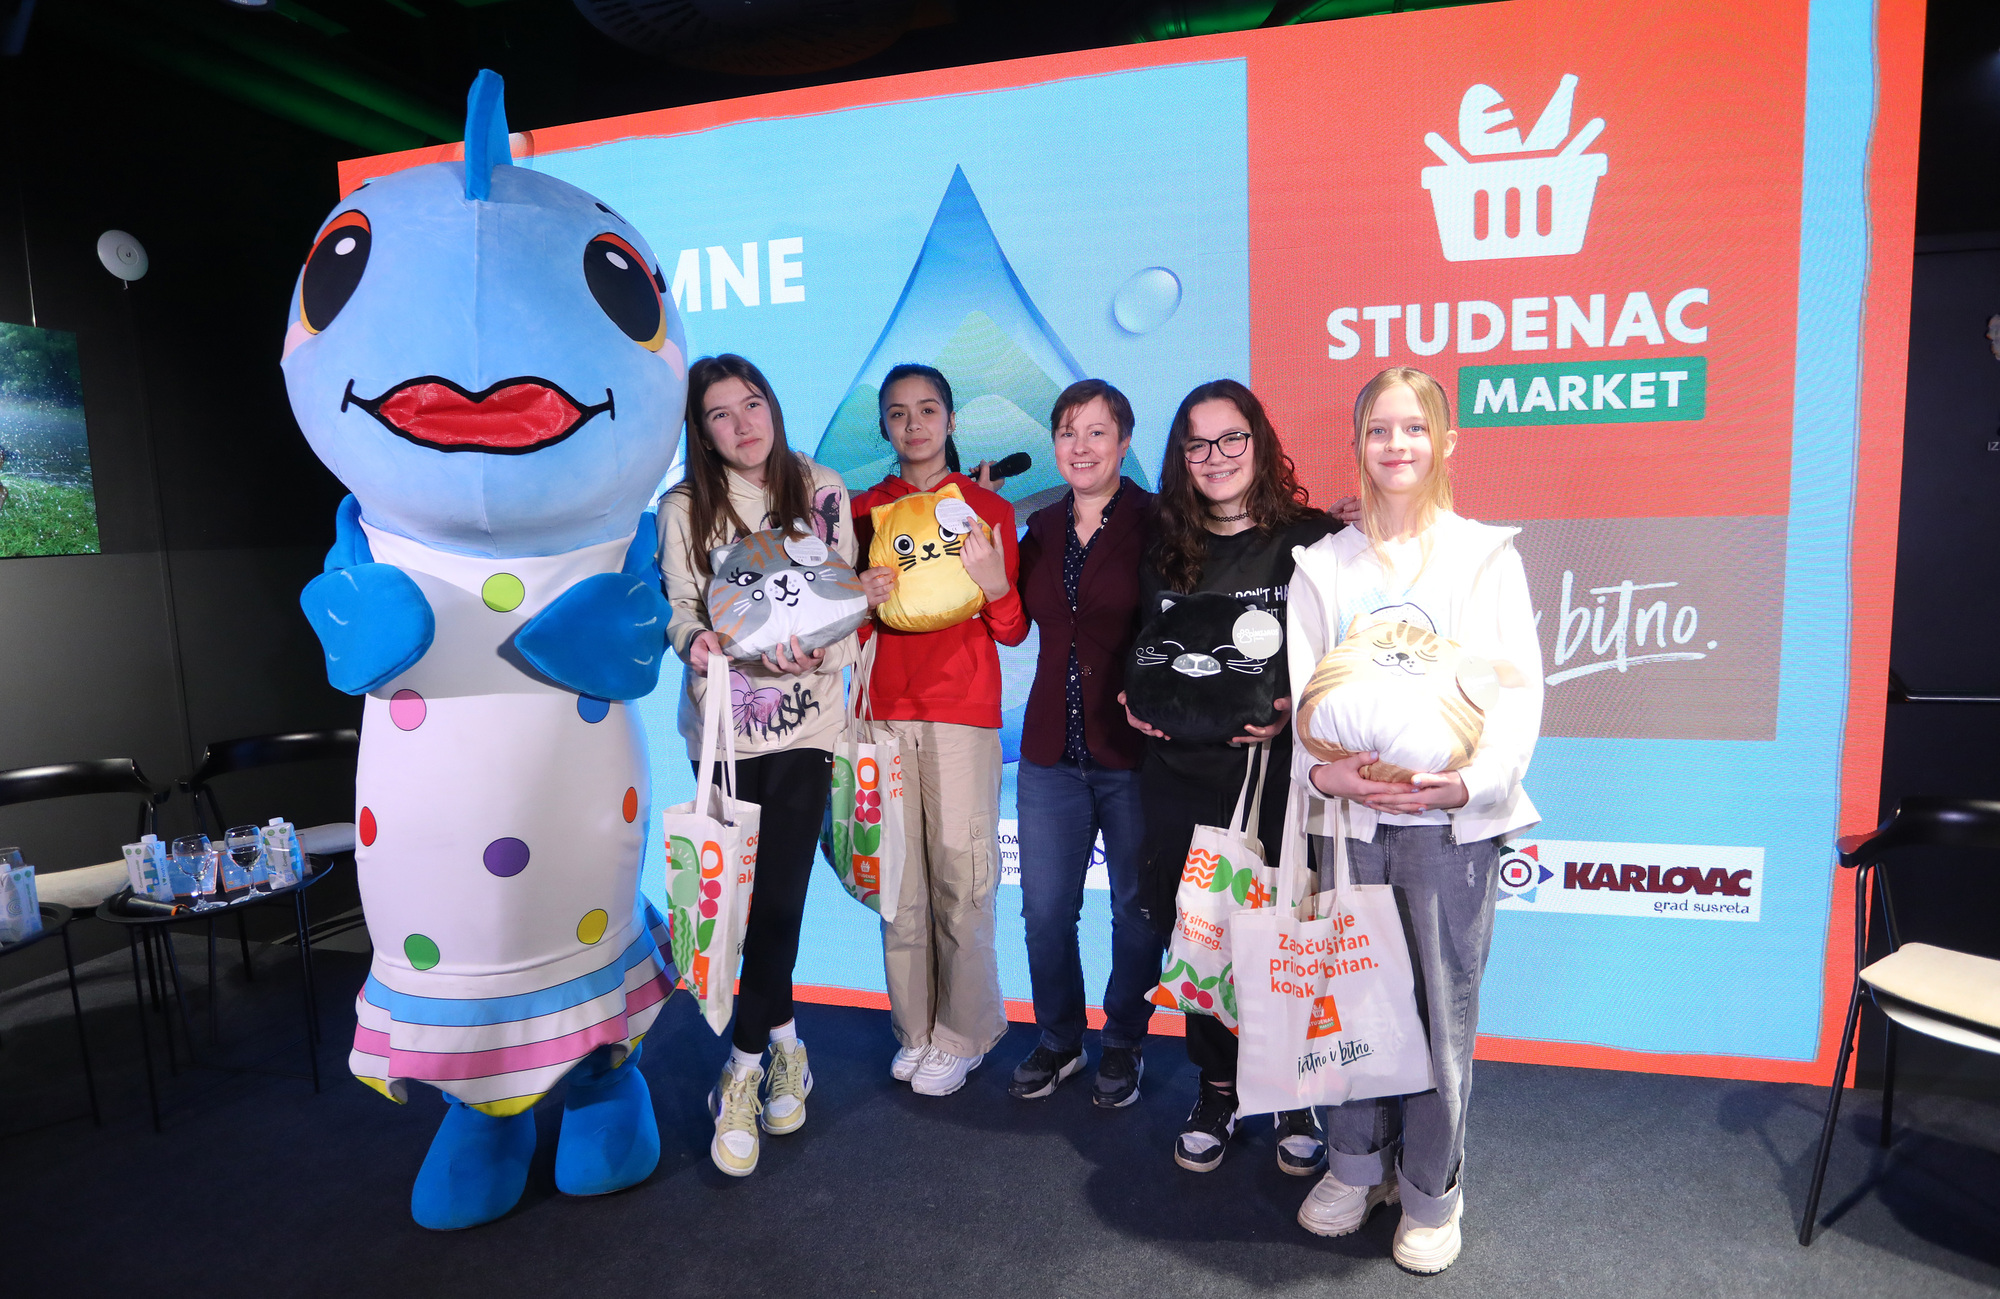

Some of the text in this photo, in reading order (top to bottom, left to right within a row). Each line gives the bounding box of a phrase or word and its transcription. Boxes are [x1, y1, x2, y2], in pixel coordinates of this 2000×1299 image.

[1326, 288, 1709, 360] STUDENAC
[1473, 371, 1688, 414] MARKET
[1550, 570, 1718, 678] bitno.
[1564, 861, 1752, 897] KARLOVAC
[1654, 899, 1750, 914] grad susreta
[1189, 915, 1224, 938] sitnog
